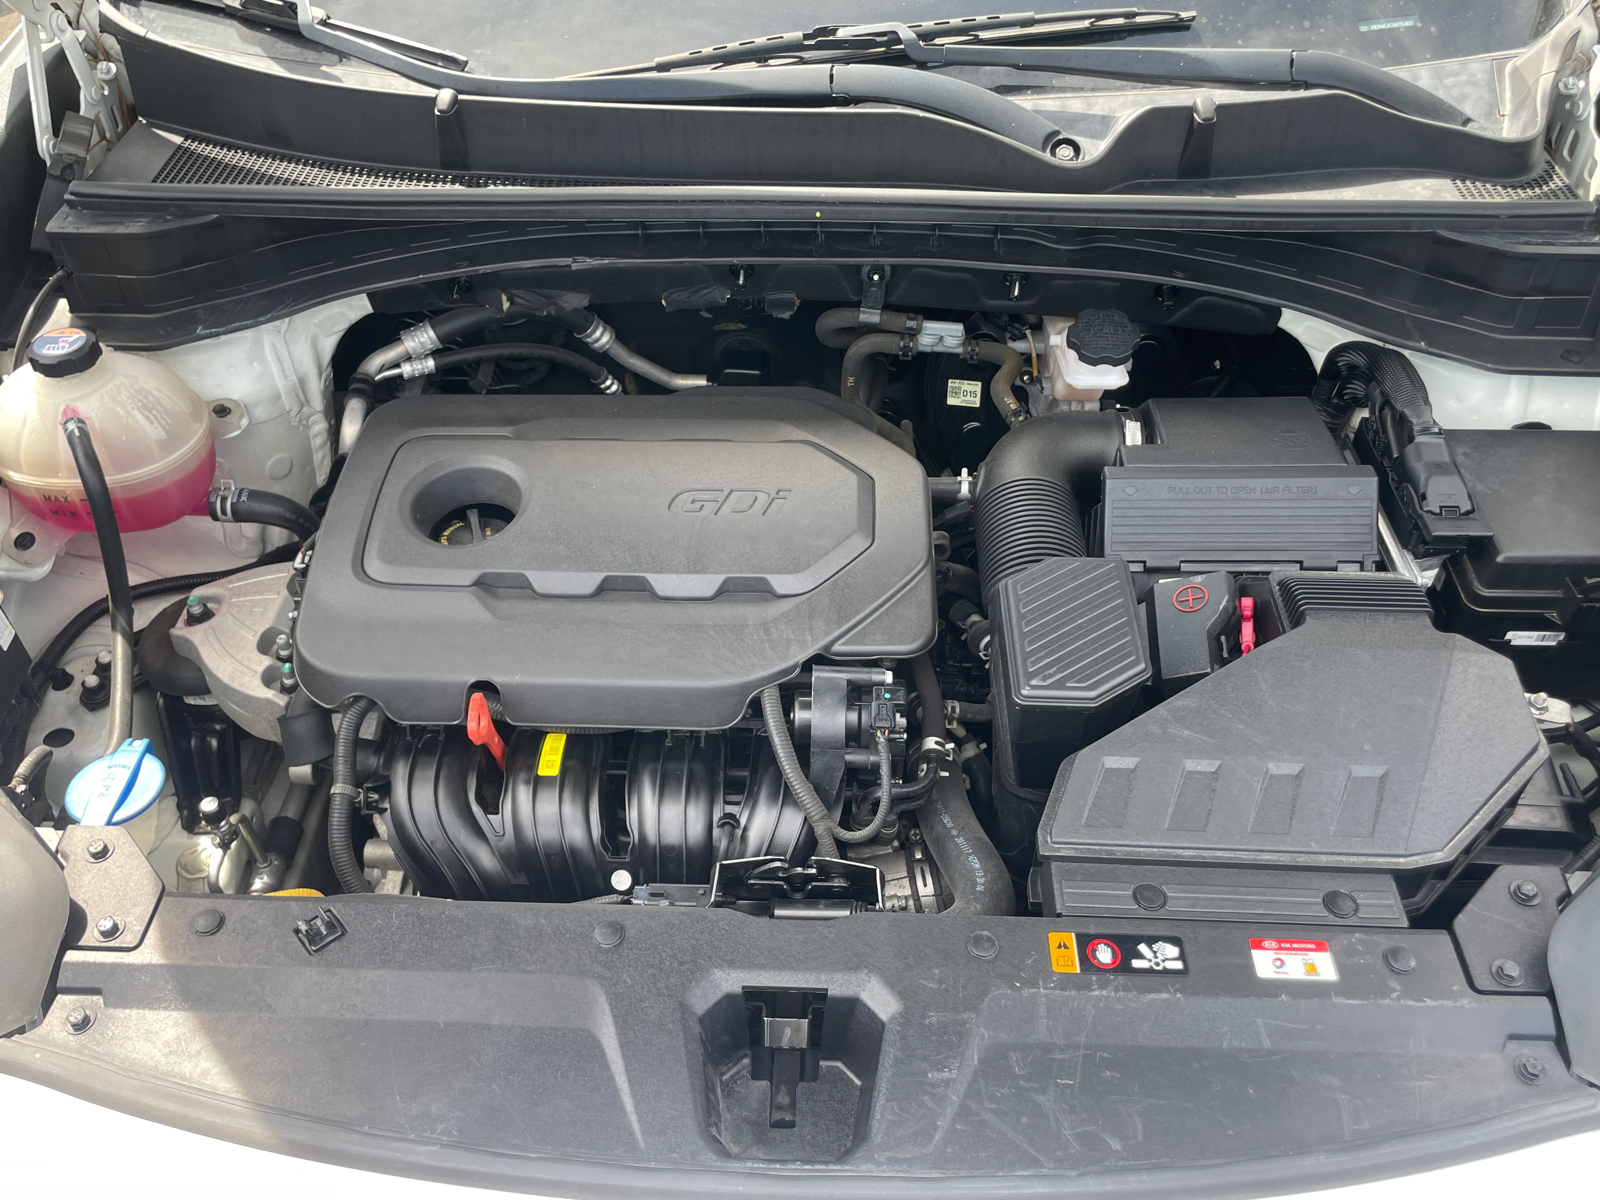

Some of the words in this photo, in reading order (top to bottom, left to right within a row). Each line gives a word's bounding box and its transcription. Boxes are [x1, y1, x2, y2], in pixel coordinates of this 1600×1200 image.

[962, 389, 978, 399] D15
[1167, 486, 1191, 494] PULL
[1194, 486, 1213, 494] OUT
[1215, 486, 1228, 494] TO
[1230, 486, 1257, 494] OPEN
[42, 494, 70, 503] MAX
[50, 508, 78, 517] MIN
[107, 763, 132, 771] WASHER
